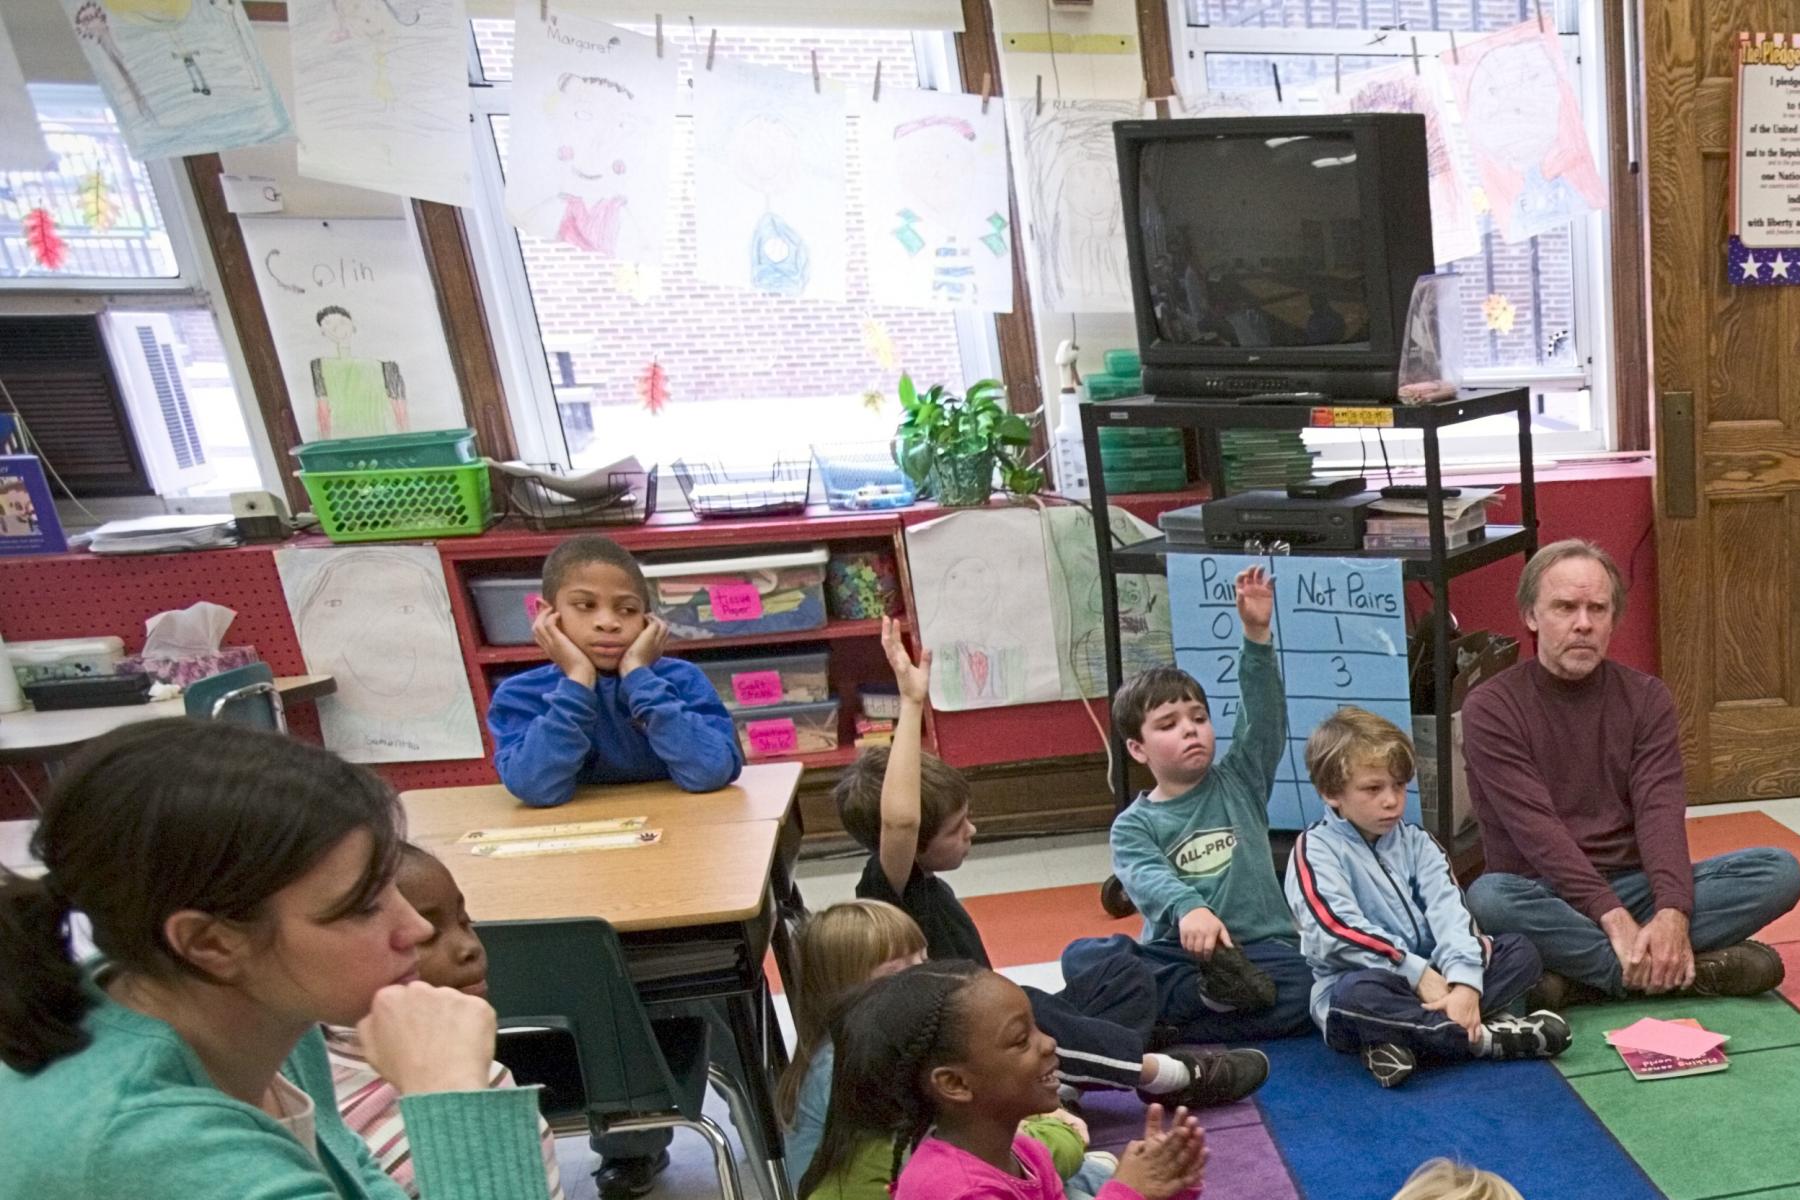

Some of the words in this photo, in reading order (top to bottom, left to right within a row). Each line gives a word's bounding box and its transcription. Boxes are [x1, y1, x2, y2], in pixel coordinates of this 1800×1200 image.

[1773, 124, 1798, 134] United
[1767, 218, 1793, 228] liberty
[264, 248, 375, 294] Colin
[1297, 571, 1337, 607] Not
[1346, 572, 1398, 613] Pairs
[1212, 612, 1233, 639] 0
[1335, 616, 1344, 644] 1
[1217, 655, 1238, 683] 2
[1330, 656, 1352, 687] 3
[1180, 835, 1235, 867] ALL-PRO
